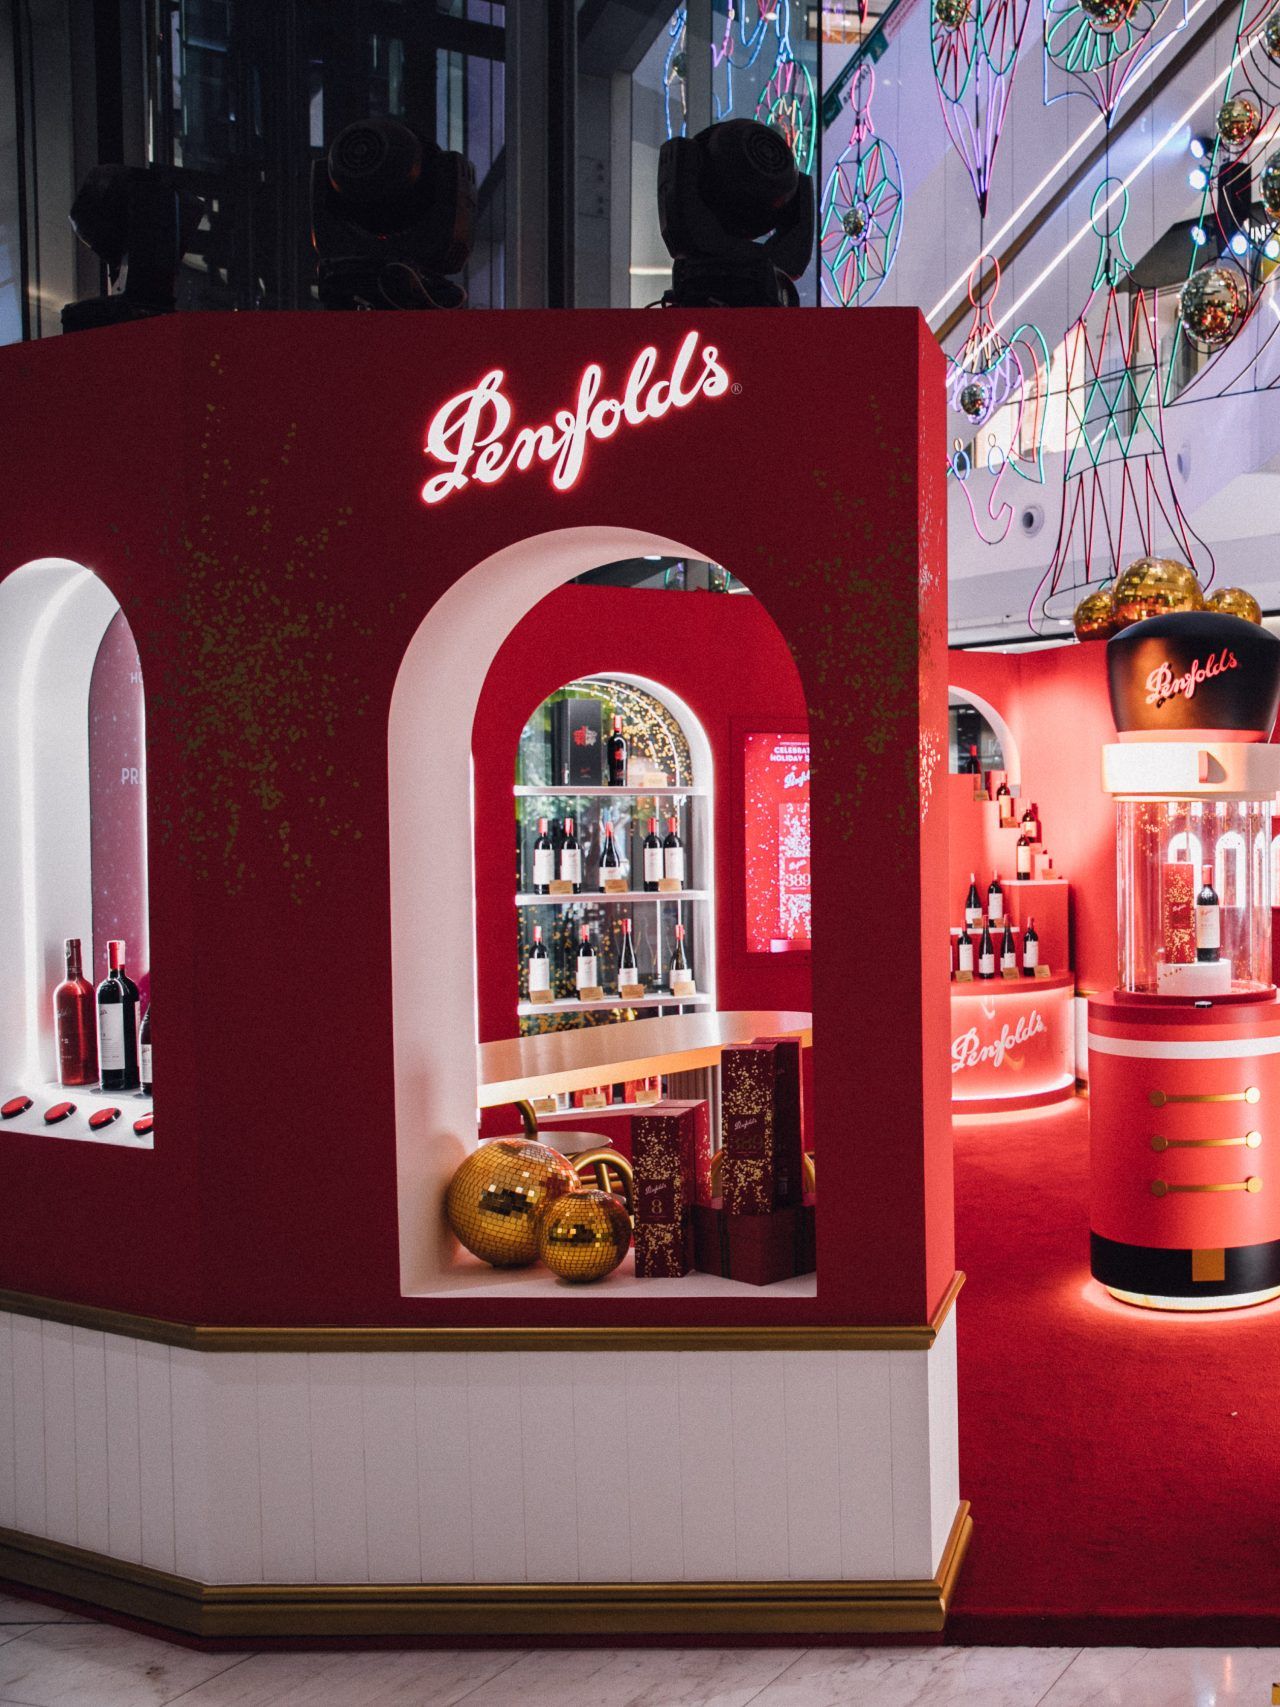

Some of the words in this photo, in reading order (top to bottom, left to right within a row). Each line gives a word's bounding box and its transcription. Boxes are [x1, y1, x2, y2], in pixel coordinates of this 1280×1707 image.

[422, 331, 728, 504] Penfolds
[1145, 648, 1238, 704] Penfolds
[770, 754, 803, 762] HOLIDAY
[951, 1007, 1045, 1073] Penfolds
[651, 1199, 662, 1214] 8
